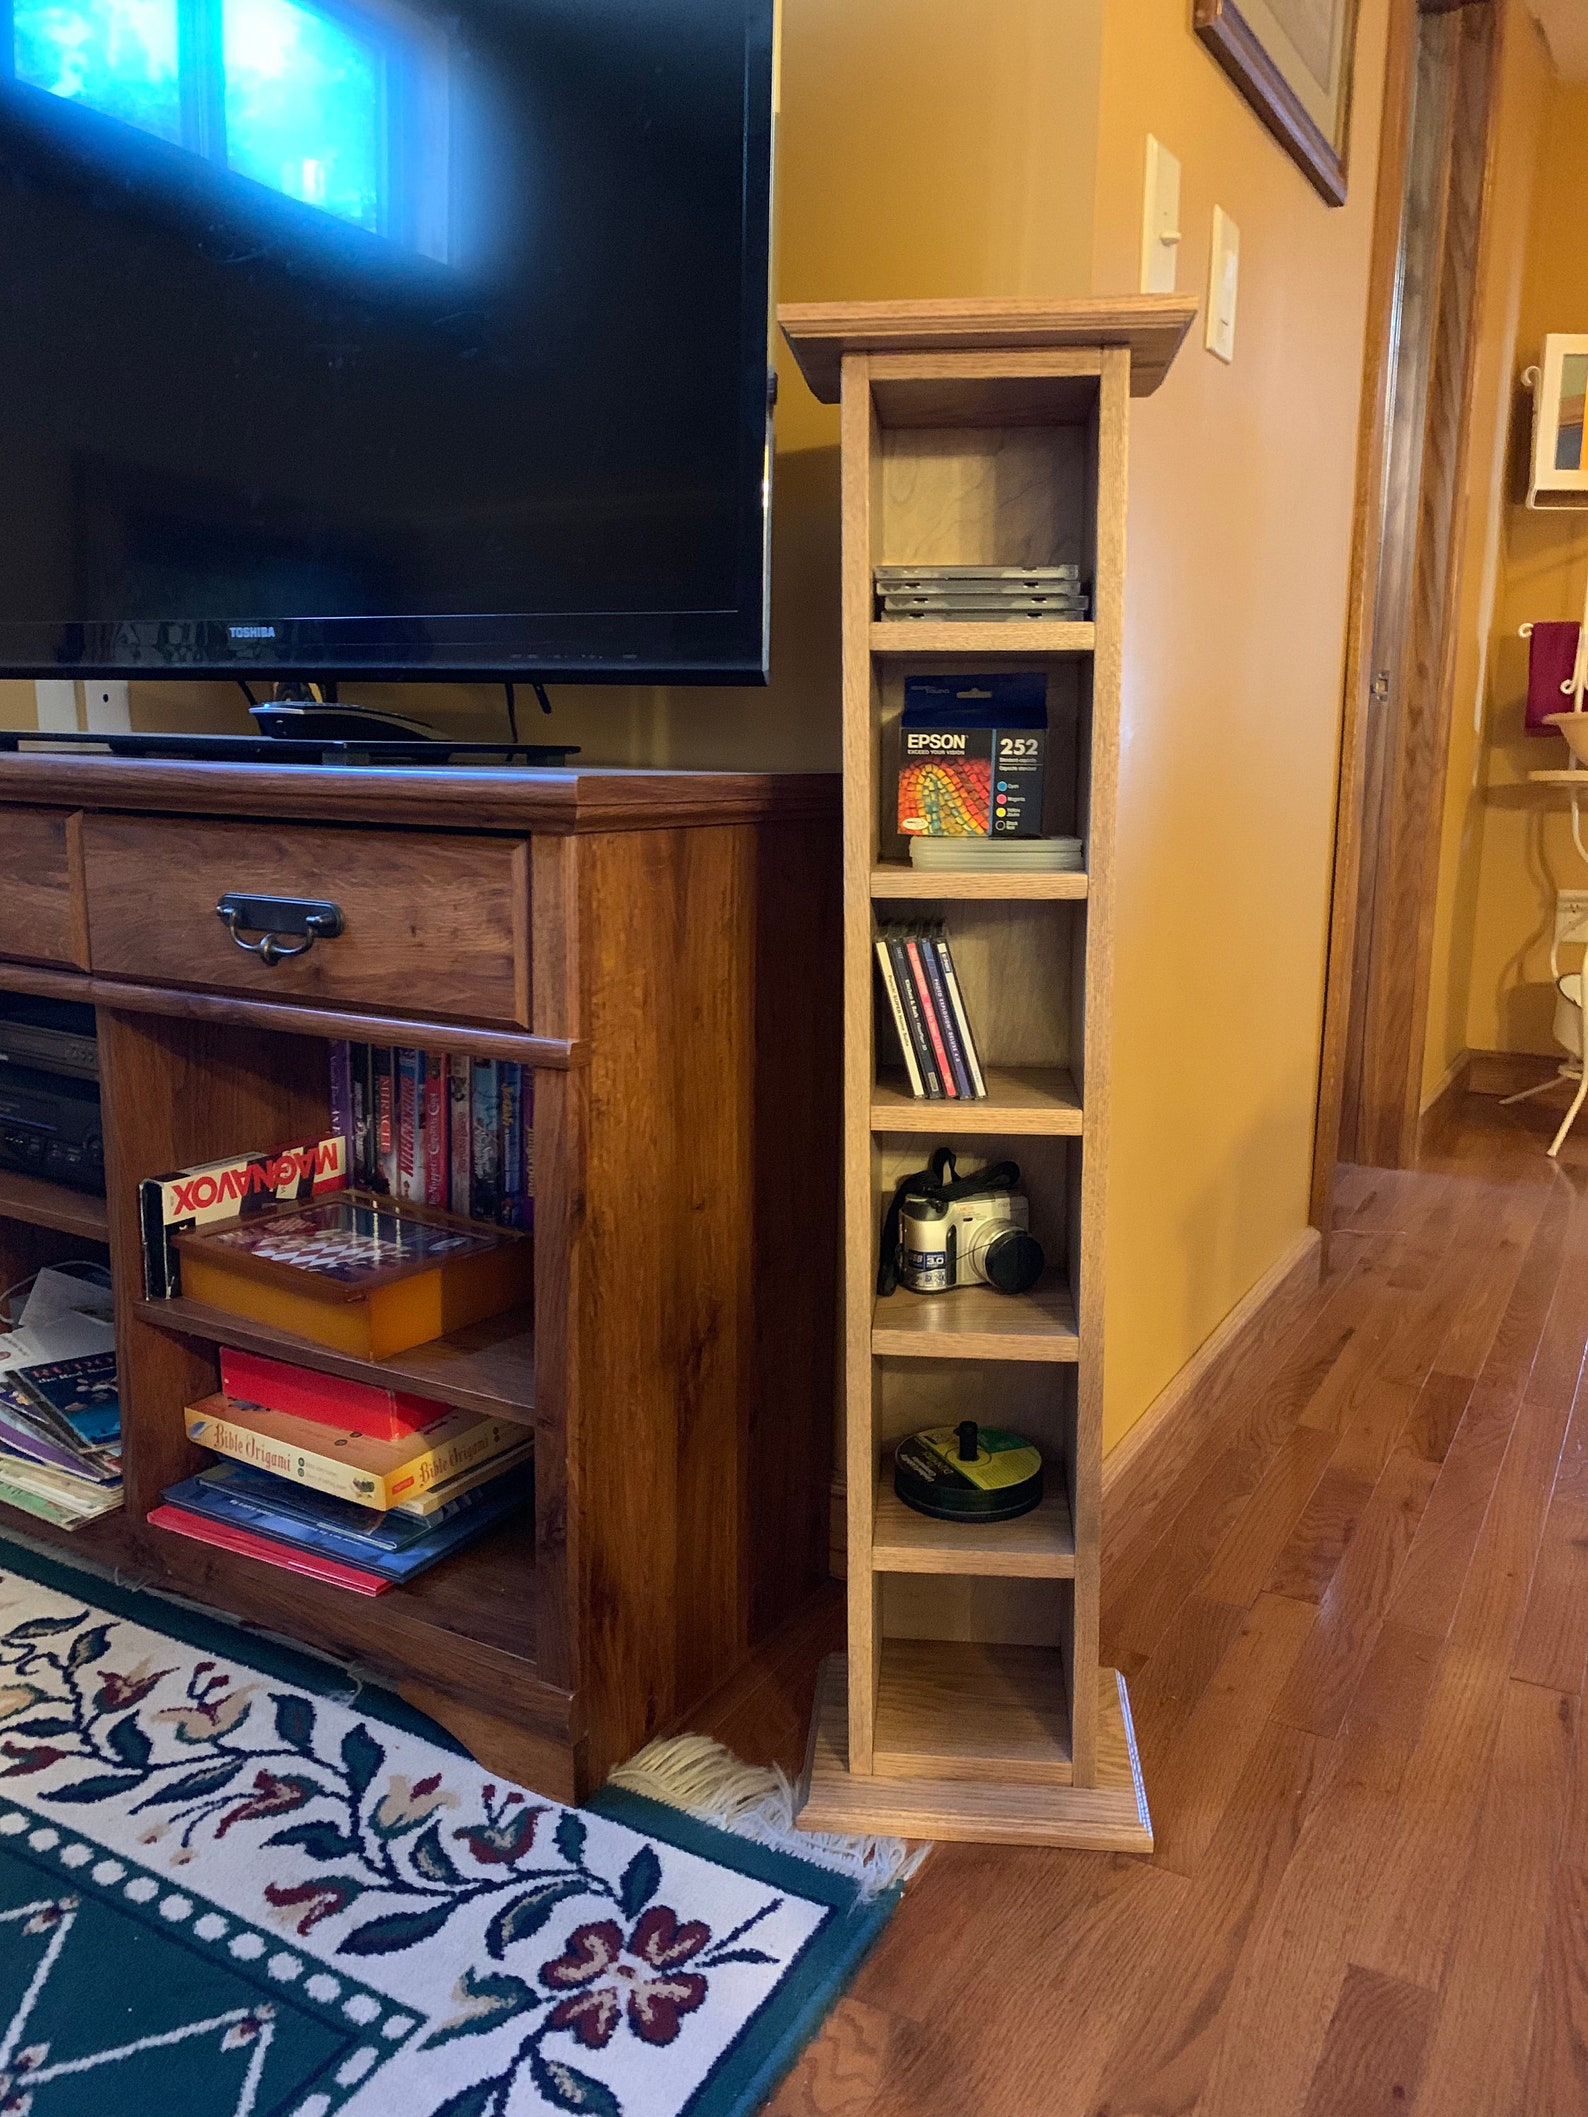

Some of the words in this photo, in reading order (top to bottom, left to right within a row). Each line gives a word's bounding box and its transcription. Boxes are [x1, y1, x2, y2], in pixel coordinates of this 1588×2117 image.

[229, 626, 276, 638] TOSHIBA
[907, 733, 966, 749] EPSON
[1000, 738, 1039, 756] 252
[893, 994, 902, 1014] SUPER
[933, 978, 944, 997] PHOTO
[948, 1032, 958, 1052] DELUXE
[171, 1142, 339, 1216] MAGNAVOX
[926, 1257, 944, 1265] 3.0
[213, 1422, 244, 1455] Bible
[245, 1434, 291, 1473] Origami
[419, 1456, 448, 1488] Bible
